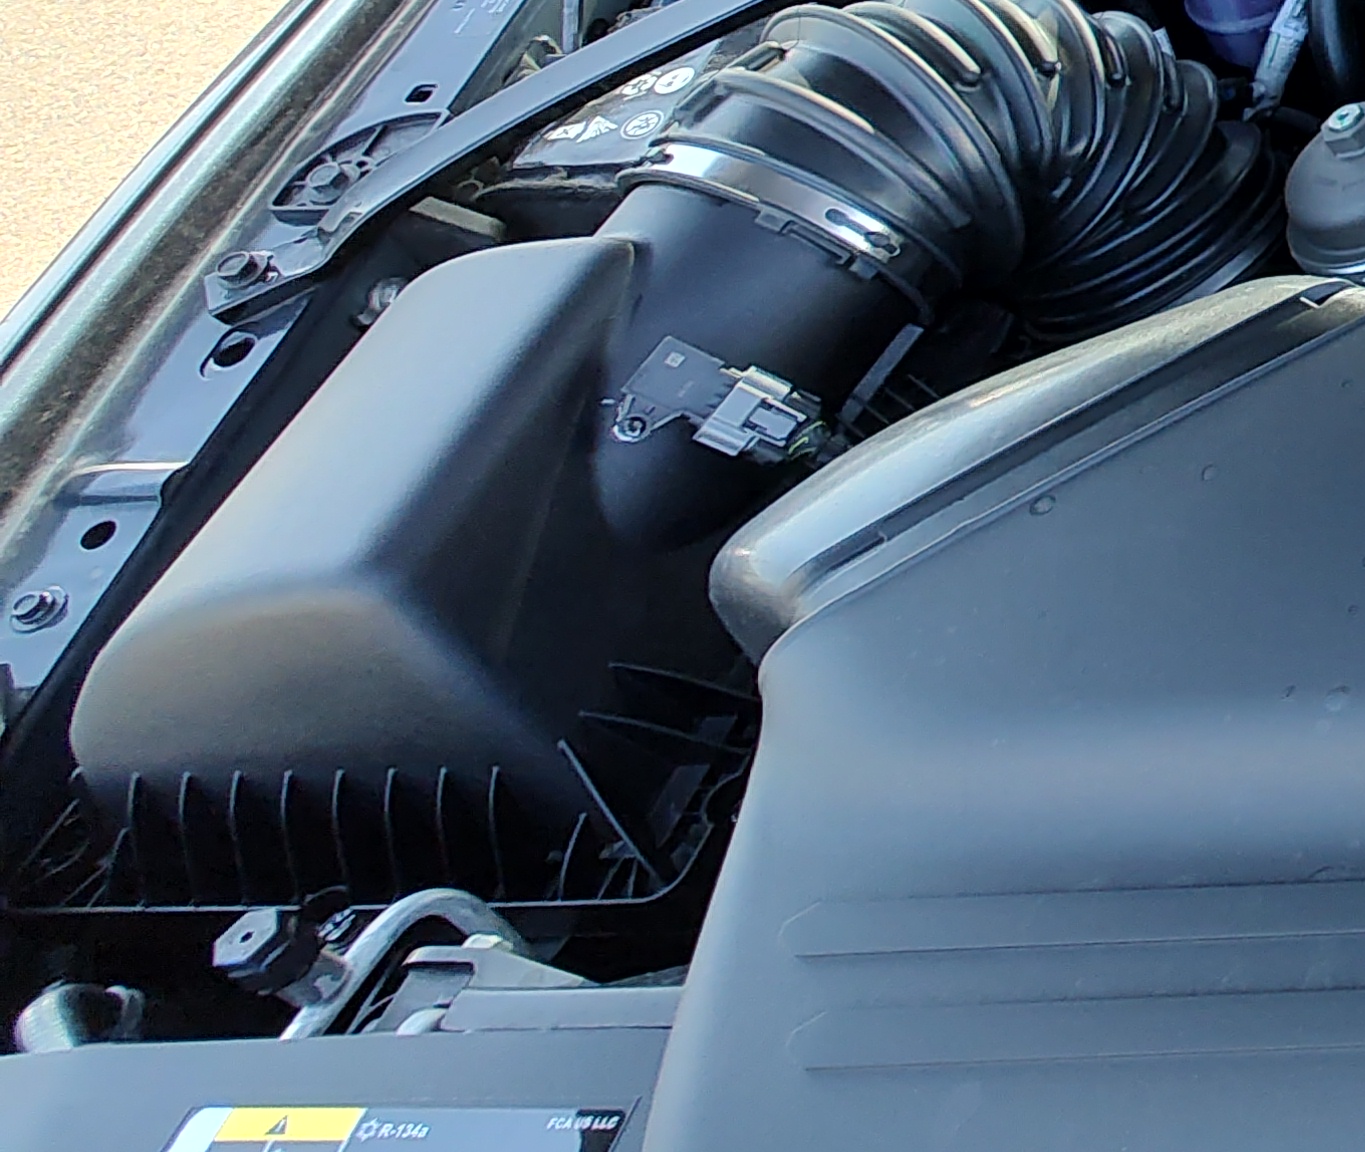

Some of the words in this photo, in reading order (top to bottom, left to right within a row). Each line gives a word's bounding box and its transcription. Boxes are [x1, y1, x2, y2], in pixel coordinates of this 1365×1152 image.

[377, 1122, 430, 1139] R-134a
[546, 1116, 573, 1130] FCA
[590, 1115, 620, 1131] LLC
